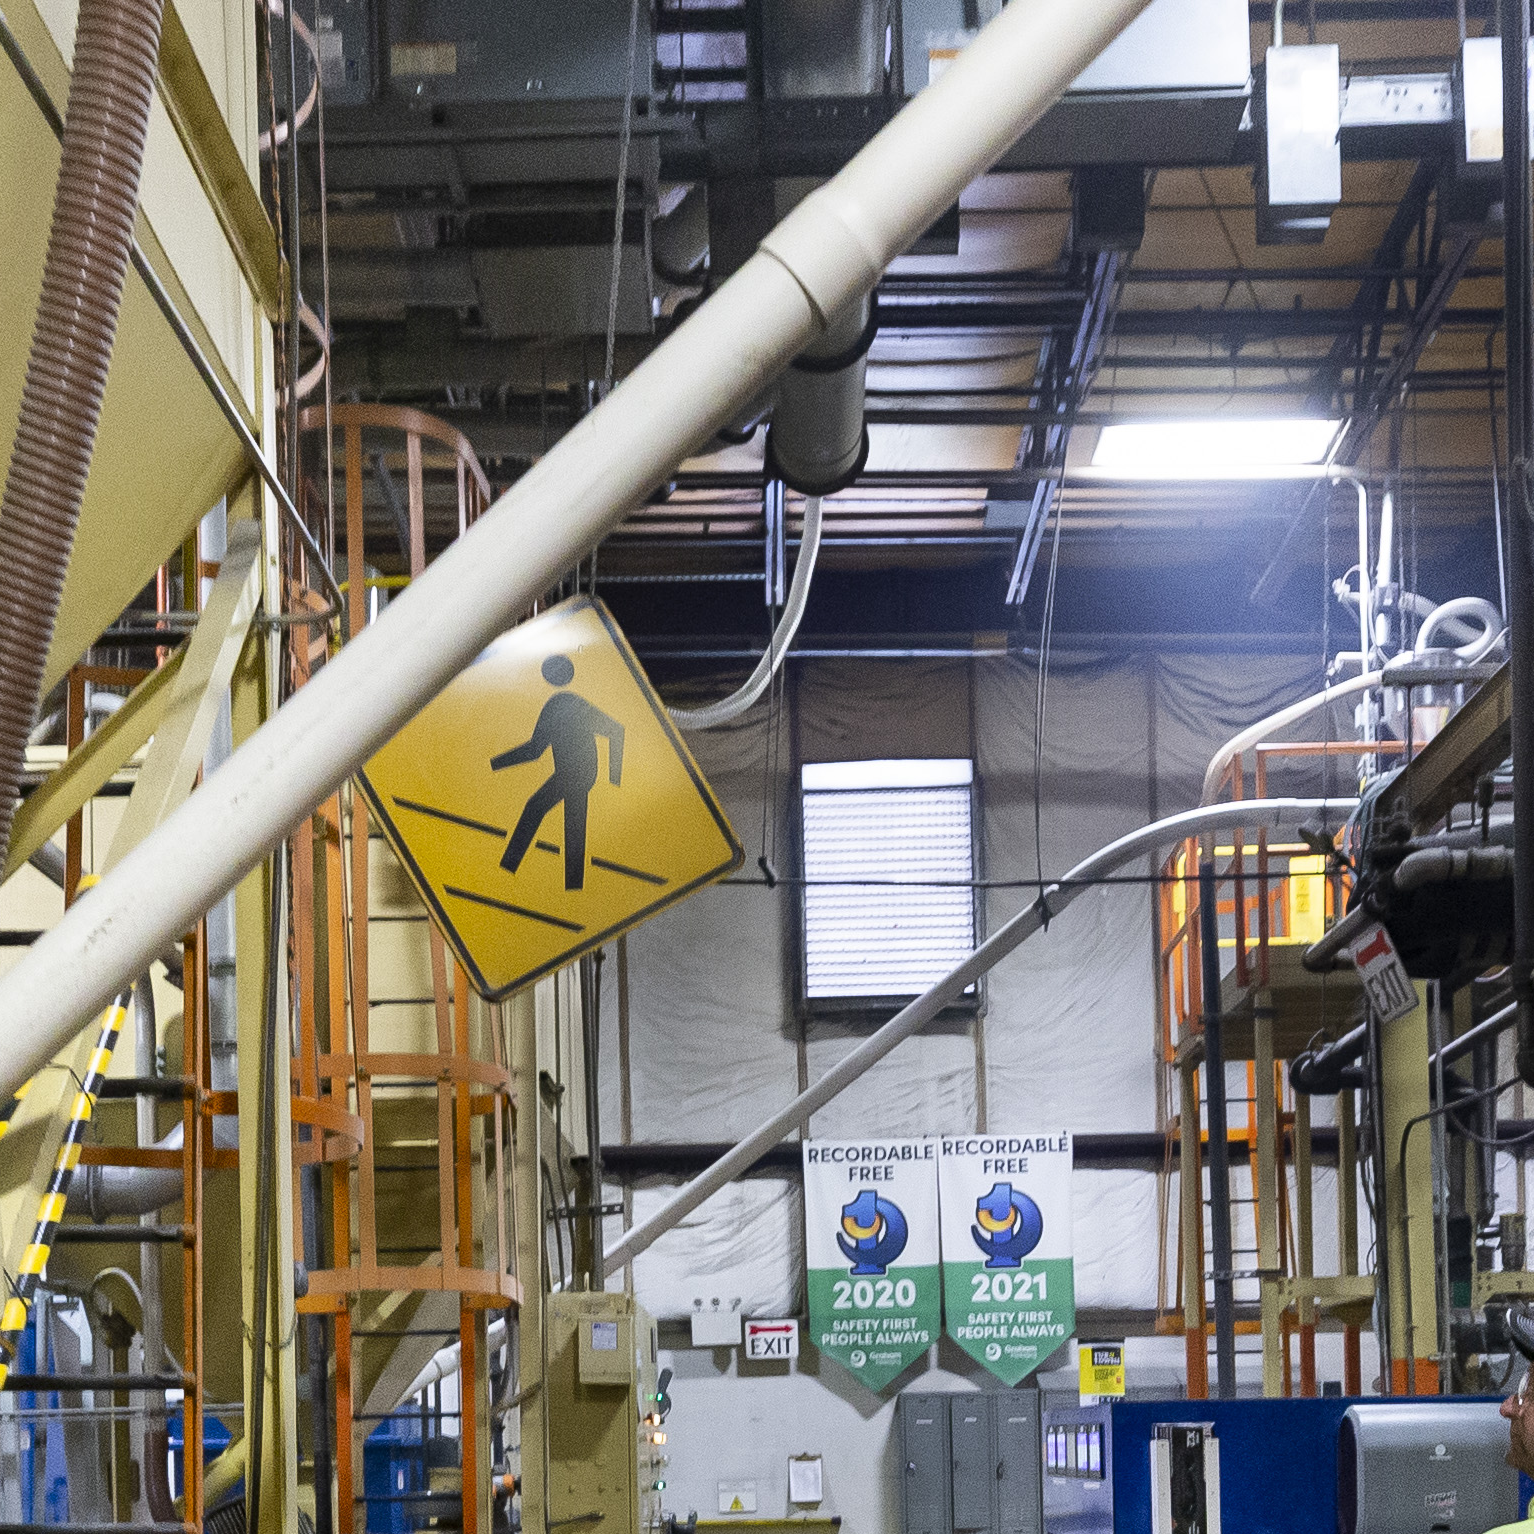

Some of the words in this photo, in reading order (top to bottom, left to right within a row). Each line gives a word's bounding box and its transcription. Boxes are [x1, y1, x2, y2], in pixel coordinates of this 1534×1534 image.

[1367, 960, 1410, 1016] EXIT
[807, 1143, 935, 1163] RECORDABLE
[942, 1136, 1069, 1156] RECORDABLE
[848, 1165, 895, 1182] FREE
[983, 1158, 1029, 1175] FREE
[832, 1278, 917, 1310] 2020
[971, 1271, 1048, 1303] 2021
[832, 1319, 880, 1332] SAFETY
[882, 1317, 918, 1330] FIRST
[968, 1312, 1015, 1325] SAFETY
[1018, 1310, 1053, 1323] FIRST
[821, 1332, 873, 1346] PEOPLE
[876, 1331, 929, 1345] ALWAYS
[957, 1326, 1009, 1339] PEOPLE
[1011, 1323, 1065, 1338] ALWAYS
[750, 1336, 793, 1356] EXIT
